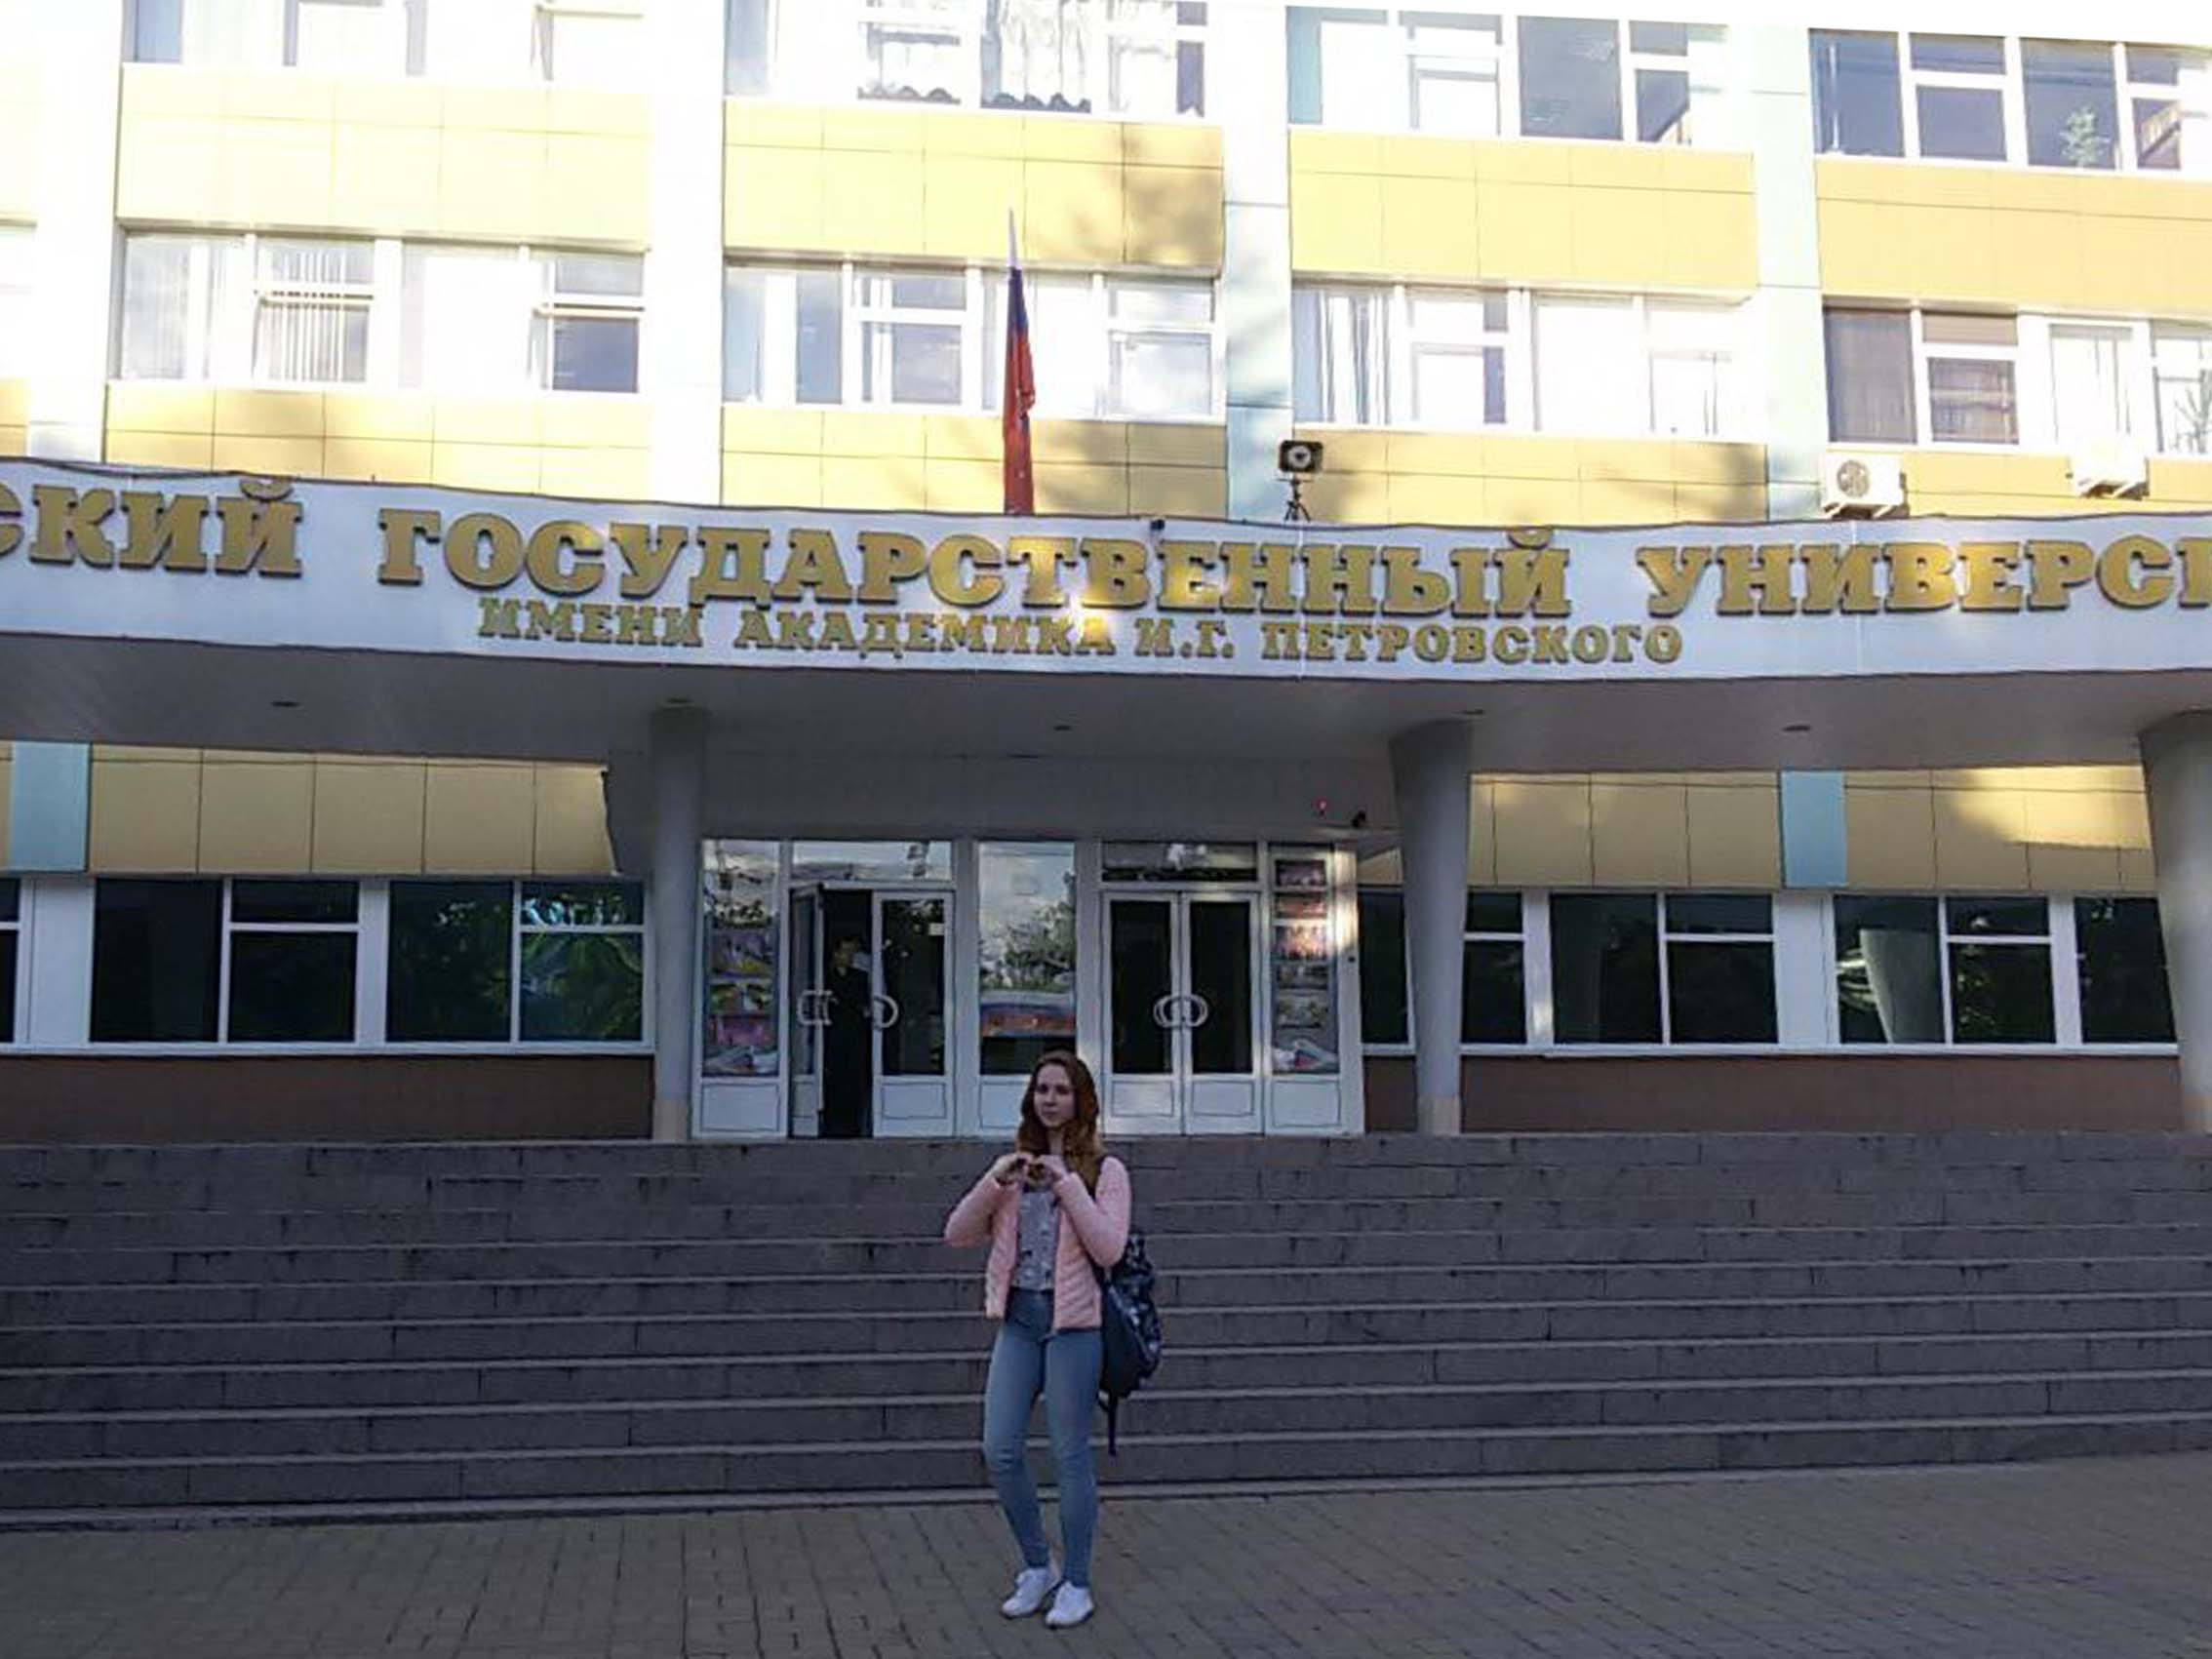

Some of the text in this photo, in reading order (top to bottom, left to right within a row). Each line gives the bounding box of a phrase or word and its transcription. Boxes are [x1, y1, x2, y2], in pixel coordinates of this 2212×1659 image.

[378, 508, 1572, 618] ГОСУДАРСТВЕННЫЙ
[479, 596, 1682, 665] ИМЕНИ АКАДЕМИКА И.Г. ПЕТРОВСКОГО
